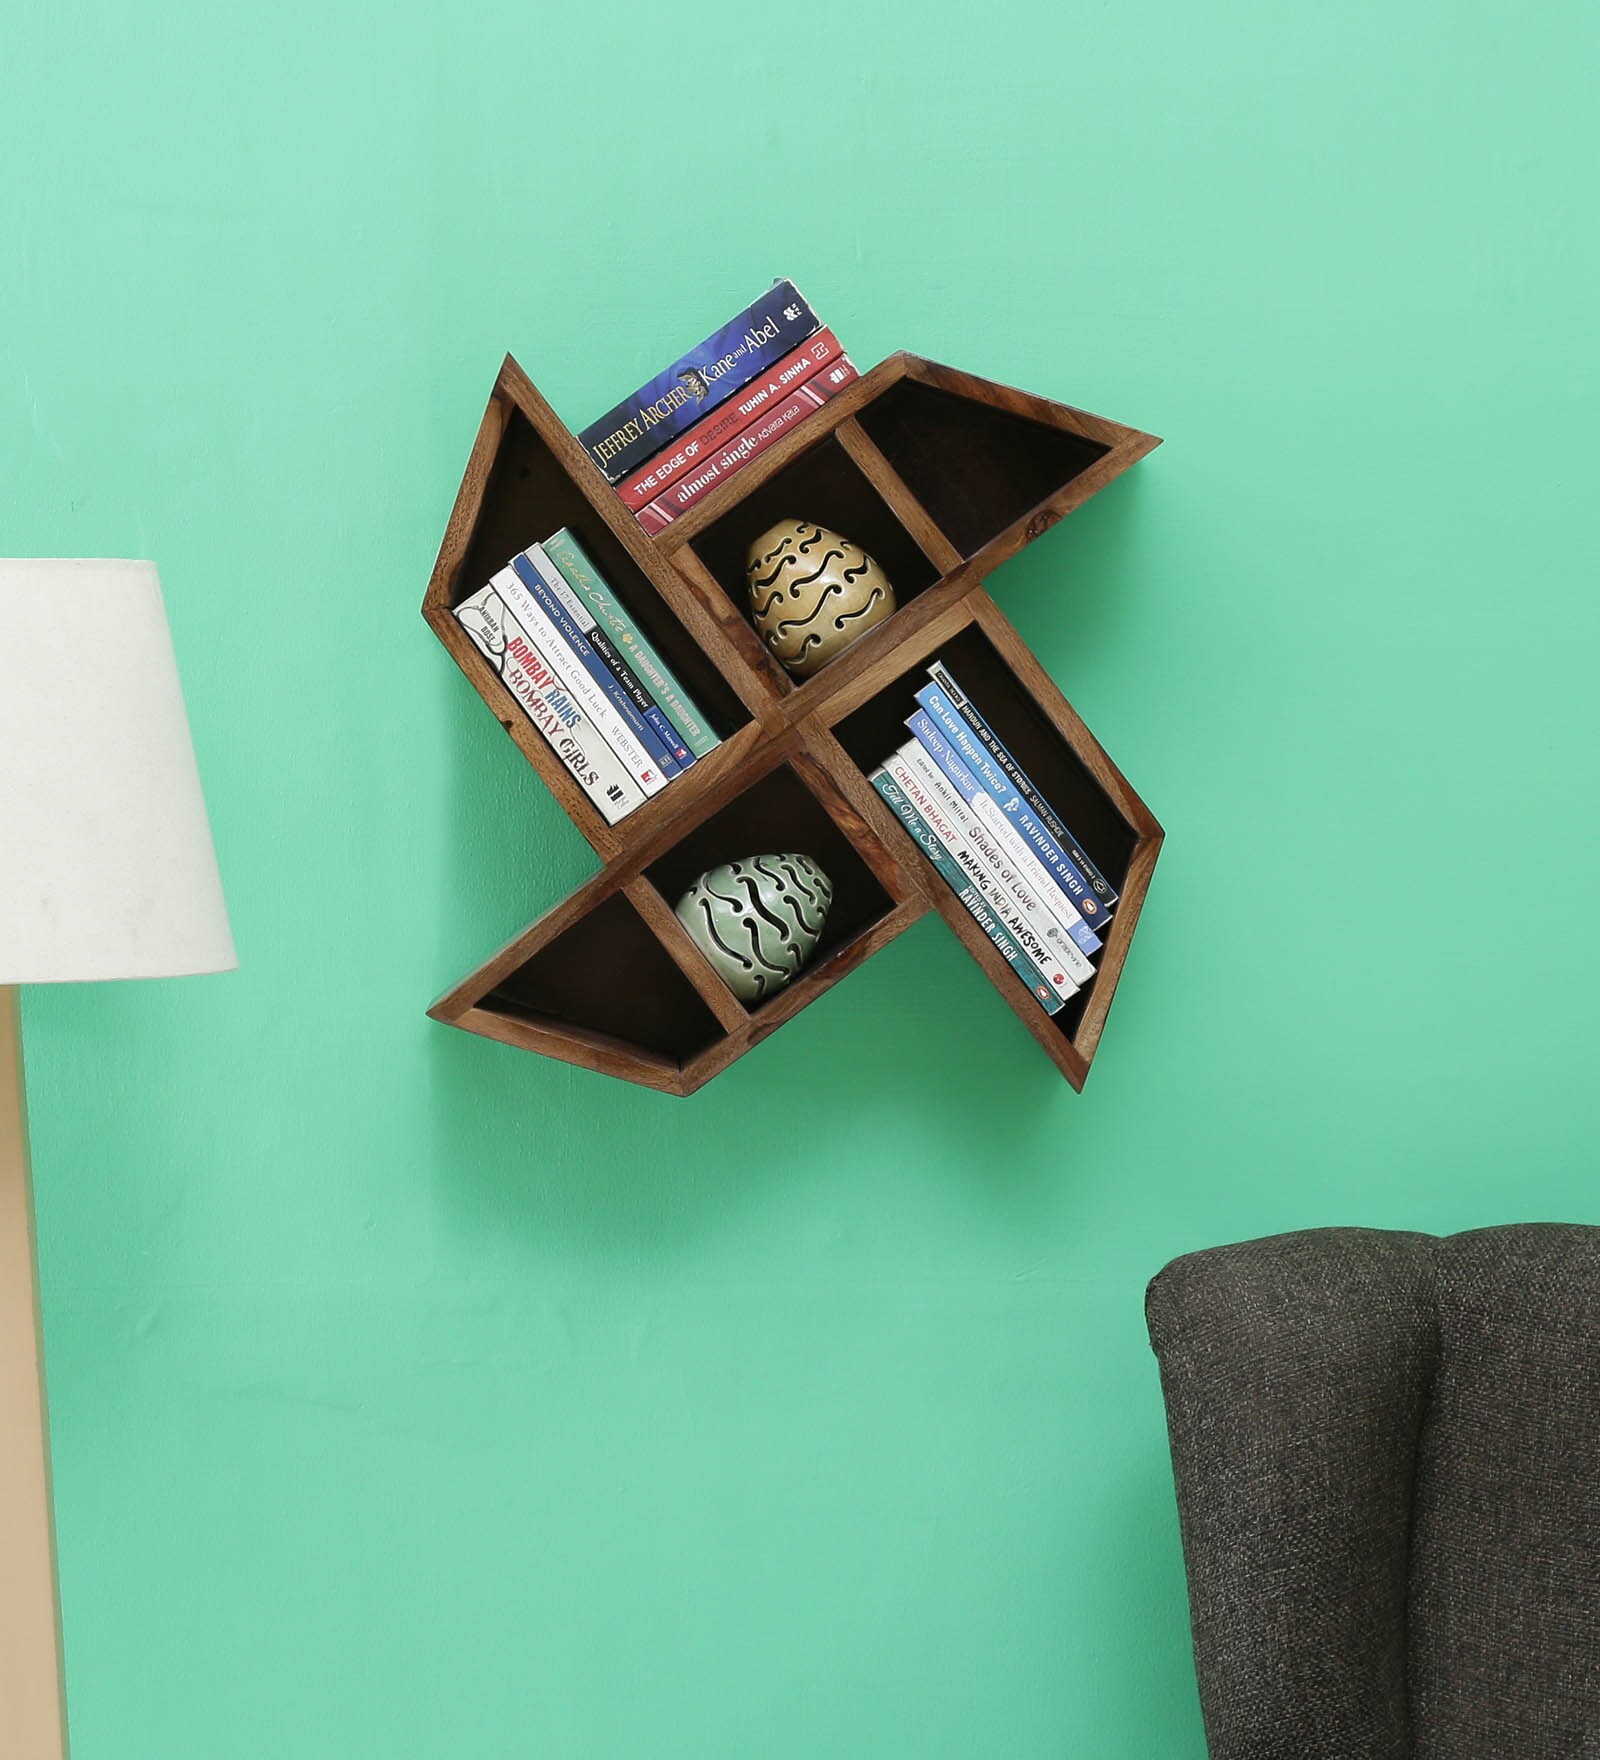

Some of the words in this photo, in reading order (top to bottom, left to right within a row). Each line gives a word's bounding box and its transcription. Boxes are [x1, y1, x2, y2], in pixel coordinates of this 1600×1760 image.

[697, 352, 737, 386] Kane
[732, 342, 747, 358] and
[741, 314, 780, 353] Abel
[737, 389, 768, 416] TUHIN
[766, 379, 781, 393] A.
[778, 356, 811, 384] SINHA
[591, 417, 645, 467] JEFFREY
[636, 383, 692, 430] ARCHER
[633, 474, 658, 496] THE
[655, 452, 686, 480] EDGE
[683, 440, 701, 457] OF
[699, 412, 737, 445] DESIRE
[675, 462, 721, 503] almost
[717, 432, 760, 472] single
[477, 605, 500, 633] ANIRBAN
[479, 625, 495, 642] BOSE
[533, 583, 561, 617] BEYOND
[557, 617, 590, 657] VIOLENCE
[549, 576, 562, 591] The
[559, 590, 568, 600] 17
[565, 598, 589, 627] Essential
[505, 581, 523, 601] 365
[517, 600, 542, 627] Ways
[537, 626, 548, 637] to
[545, 636, 573, 669] Attract
[568, 668, 591, 695] Good
[586, 693, 609, 719] Luck
[506, 635, 554, 691] BOMBAY
[544, 687, 582, 729] RAINS
[589, 630, 613, 658] Qualities
[609, 656, 619, 667] of
[618, 670, 635, 689] Team
[631, 688, 650, 709] Player
[628, 643, 638, 652] A
[633, 650, 670, 695] DAUGHTER'S
[506, 668, 564, 739] BOMBAY
[556, 735, 600, 787] GIRLS
[665, 693, 675, 702] A
[669, 699, 701, 737] DAUGHTER
[609, 725, 644, 768] WEBSTER
[914, 718, 946, 754] Sudeep
[940, 750, 976, 793] Nagarkar
[927, 694, 946, 714] Can
[940, 711, 960, 734] Love
[953, 731, 984, 766] Happen
[978, 761, 1007, 794] Twice?
[961, 705, 982, 729] HAROUN
[978, 727, 991, 741] AND
[988, 740, 1000, 753] THE
[996, 751, 1008, 764] SEA
[1004, 762, 1014, 773] OF
[1010, 770, 1031, 795] STORIES
[880, 780, 904, 806] Tell
[893, 765, 926, 804] CHETAN
[923, 803, 957, 844] BHAGAT
[897, 801, 921, 827] Me
[933, 780, 951, 801] Ankit
[948, 800, 968, 823] Mittal
[1029, 794, 1048, 817] SALMAN
[1044, 814, 1063, 837] RUSHDIE
[913, 826, 921, 834] a
[916, 829, 947, 863] Story
[979, 798, 989, 808] It
[985, 806, 1012, 839] Started
[1007, 835, 1025, 856] with
[1025, 860, 1050, 888] Friend
[1044, 886, 1073, 920] Request
[1018, 814, 1059, 864] RAVINDER
[1054, 862, 1083, 896] SINGH
[967, 824, 1005, 869] Shades
[1000, 867, 1015, 883] of
[1010, 881, 1037, 912] Love
[956, 848, 992, 890] MAKING
[986, 887, 1013, 918] INDIA
[1007, 914, 1051, 967] AWESOME
[958, 887, 996, 933] RAVINDER
[990, 931, 1017, 962] SINGH
